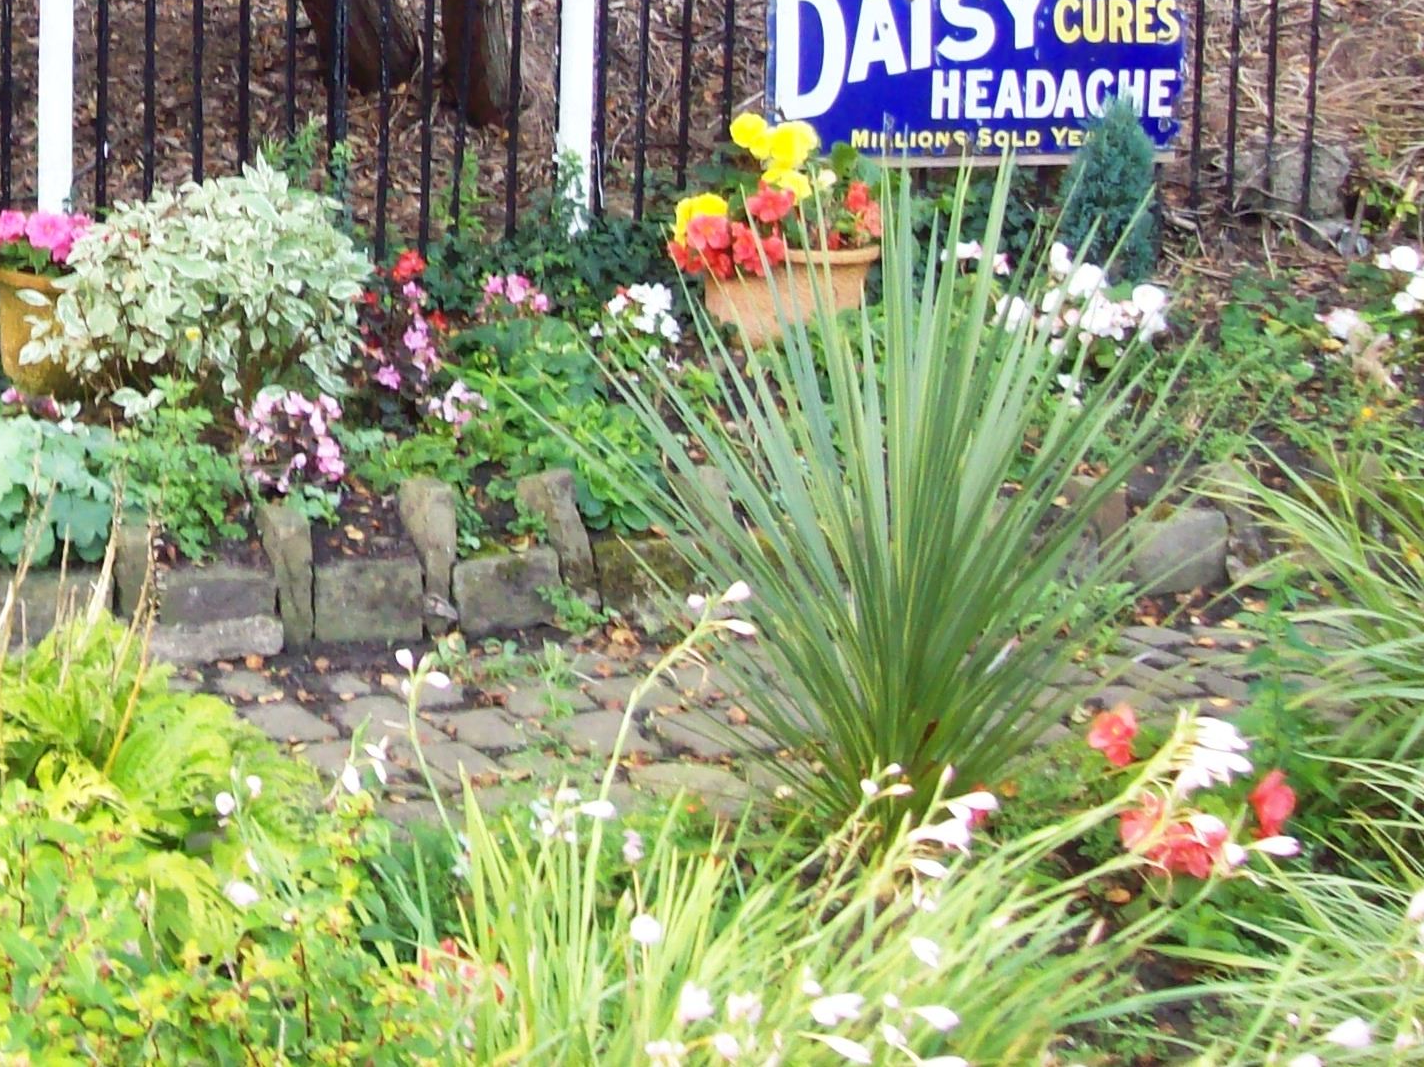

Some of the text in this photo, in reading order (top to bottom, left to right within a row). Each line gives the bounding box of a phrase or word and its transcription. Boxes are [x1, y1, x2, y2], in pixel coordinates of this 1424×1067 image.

[931, 67, 1175, 120] HEADACHE
[851, 129, 965, 149] MILLIONS
[979, 129, 1040, 149] SOLD
